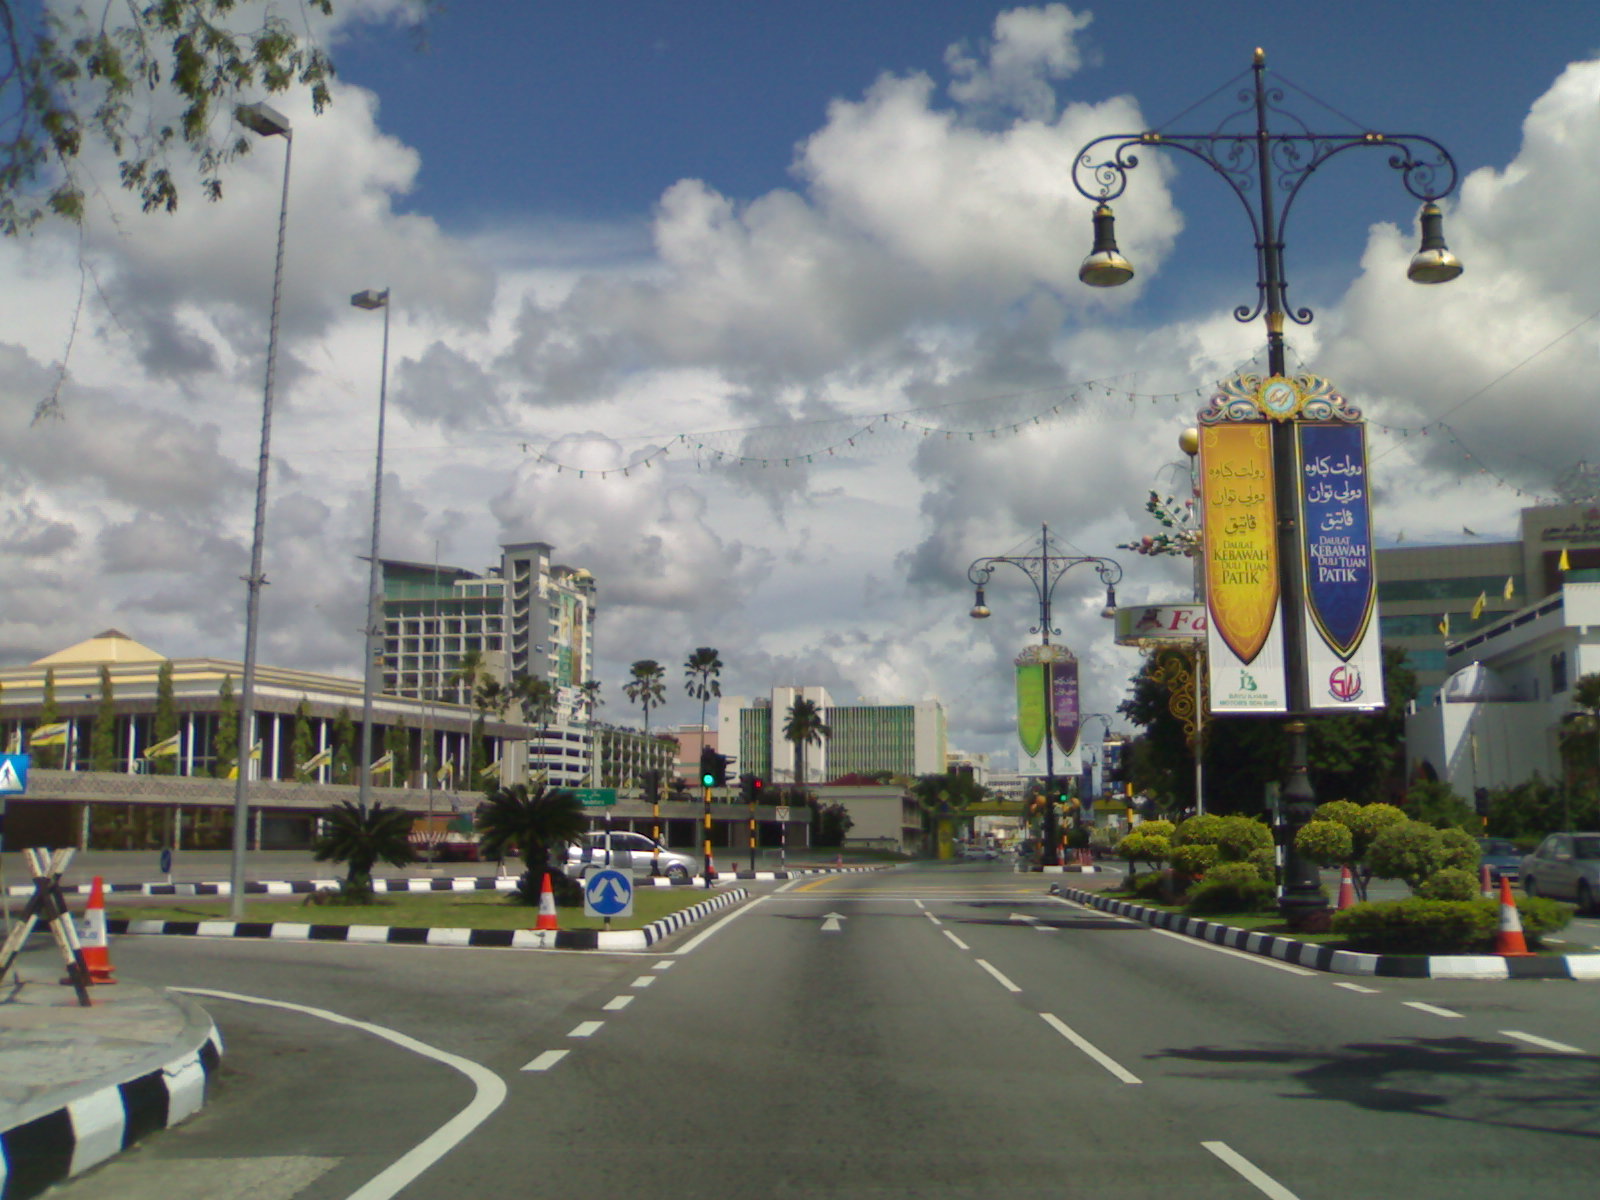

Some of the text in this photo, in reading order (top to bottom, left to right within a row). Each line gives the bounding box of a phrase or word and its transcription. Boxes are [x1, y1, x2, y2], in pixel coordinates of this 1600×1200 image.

[1319, 535, 1351, 545] DAULAT
[1213, 549, 1269, 561] KEBAWAH
[1310, 543, 1366, 557] KEBAWAH
[1222, 570, 1260, 585] PATIK
[1319, 567, 1358, 583] PATIK
